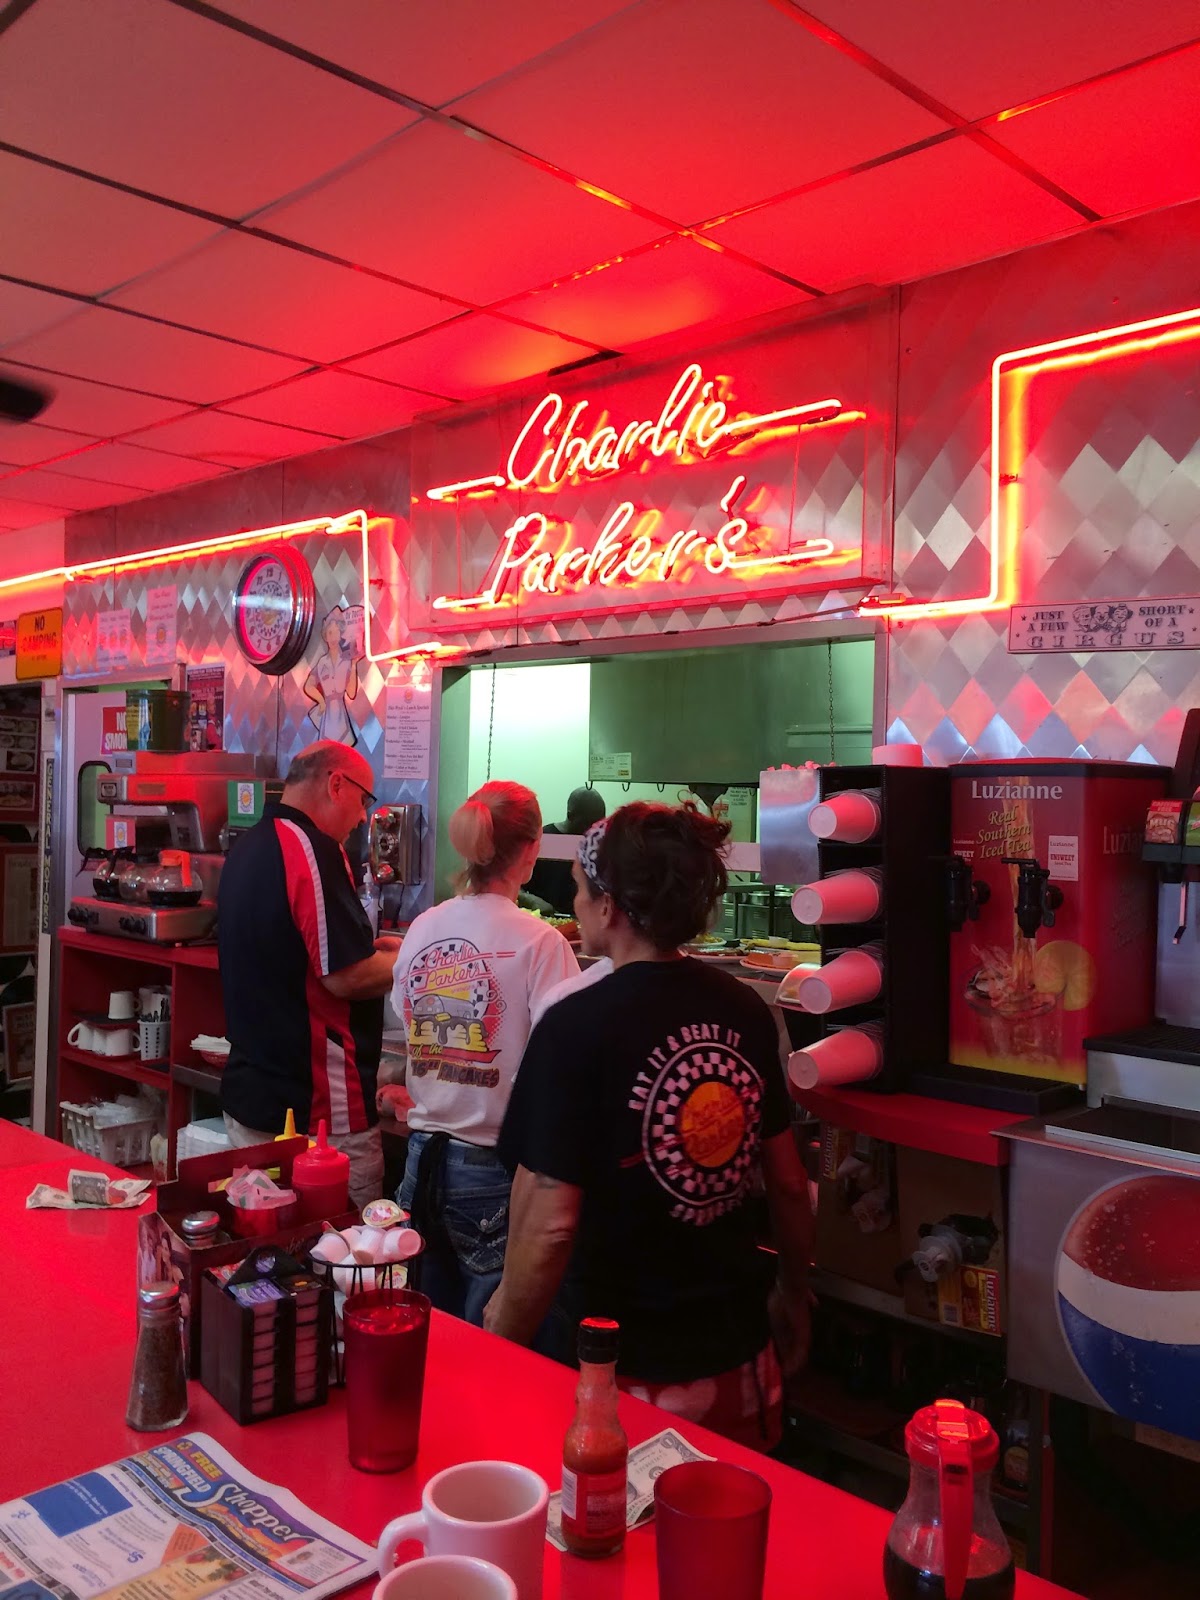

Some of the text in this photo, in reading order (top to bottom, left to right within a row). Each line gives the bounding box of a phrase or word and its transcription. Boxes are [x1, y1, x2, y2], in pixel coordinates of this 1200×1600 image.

[506, 363, 842, 487] Charlie
[433, 475, 834, 610] Parker's
[1033, 610, 1065, 621] JUST
[1138, 604, 1188, 616] SHORT
[34, 616, 45, 630] NO
[1027, 621, 1069, 632] A FEW
[1144, 616, 1179, 628] OF A
[1026, 630, 1186, 649] CIRCUS
[971, 780, 1063, 799] Luzianne
[45, 763, 54, 848] GENERAL
[988, 805, 1019, 825] Real
[976, 823, 1032, 844] Southern
[1149, 818, 1176, 829] MUG
[979, 840, 1032, 859] Iced Tea
[1102, 825, 1144, 856] Luzian
[1050, 853, 1075, 862] UNSWEET
[43, 859, 51, 929] MOTORS
[424, 942, 476, 969] Charlie
[428, 1043, 443, 1056] the
[647, 1046, 668, 1070] IT
[680, 1023, 720, 1044] BEAT
[726, 1028, 742, 1048] IT
[437, 1060, 500, 1089] PANCAKES
[986, 1274, 997, 1330] Luzianne
[153, 1446, 212, 1493] SPRINGFIELD
[189, 1451, 223, 1480] FREE
[172, 1483, 314, 1543] Shopper
